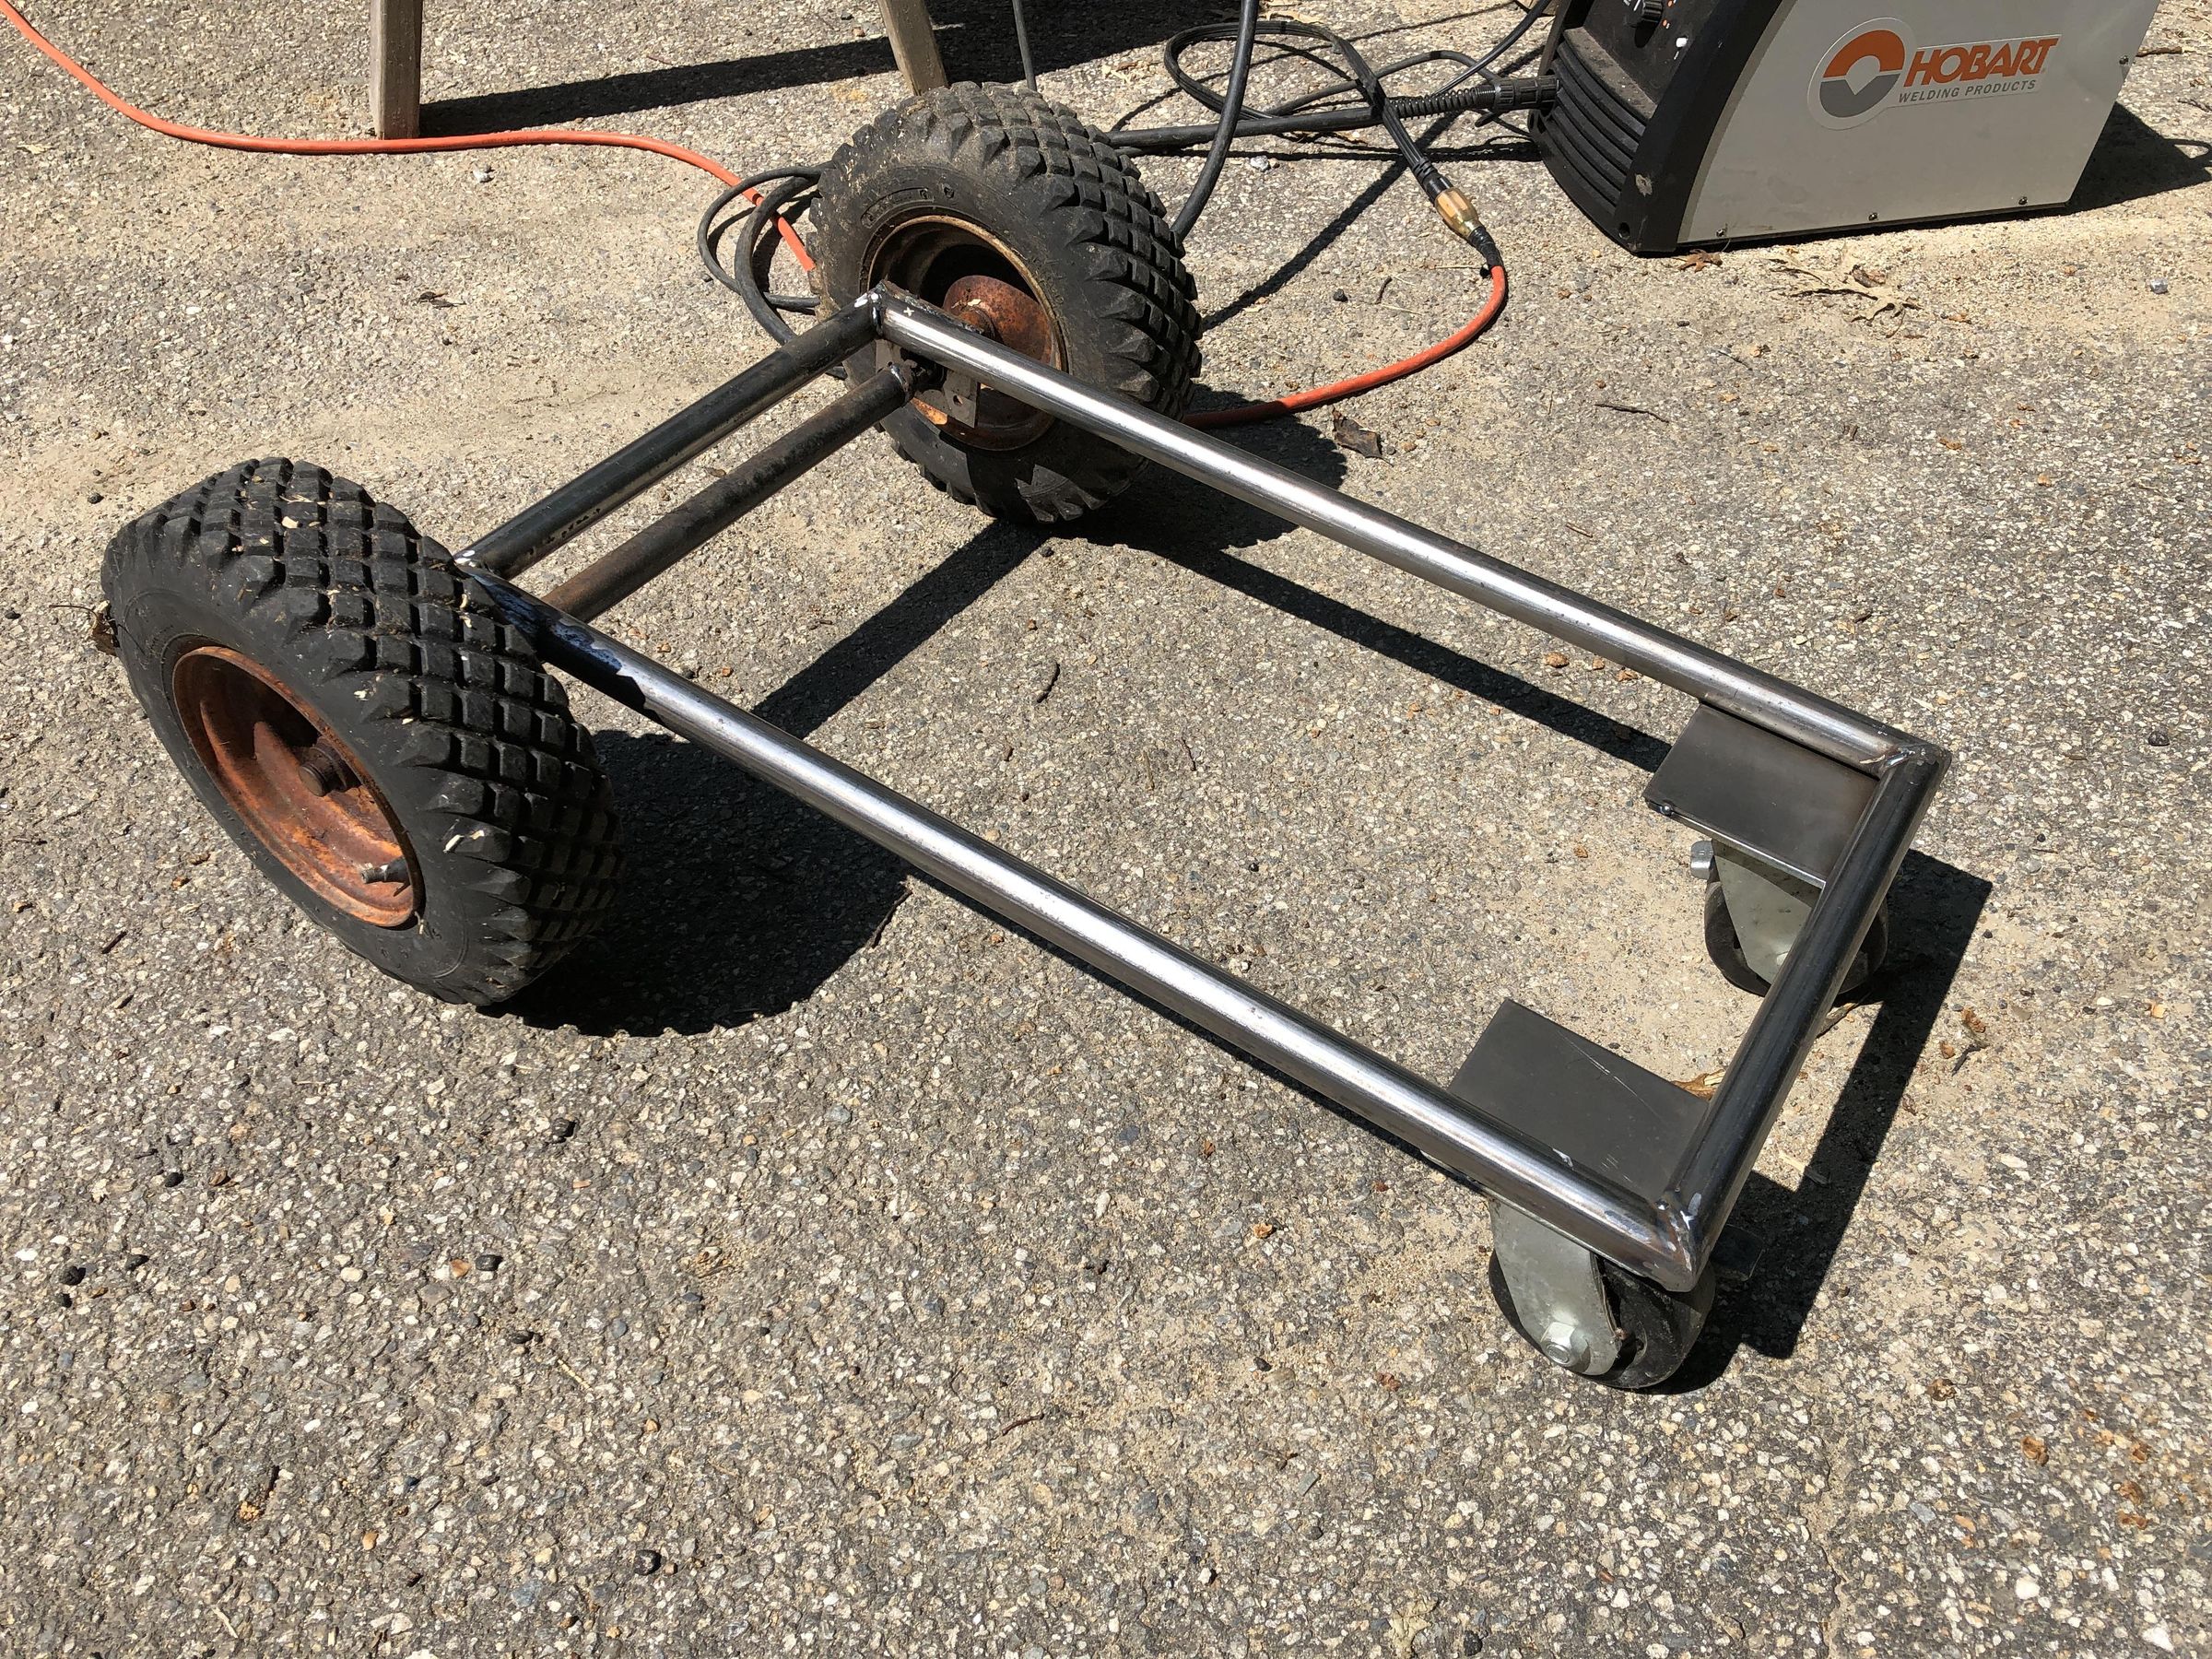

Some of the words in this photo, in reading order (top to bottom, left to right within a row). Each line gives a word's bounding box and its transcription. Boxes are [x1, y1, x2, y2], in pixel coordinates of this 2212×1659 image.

[1903, 38, 2059, 88] HOBART
[1898, 87, 1960, 103] WELDING
[1965, 79, 2037, 97] PRODUCTS
